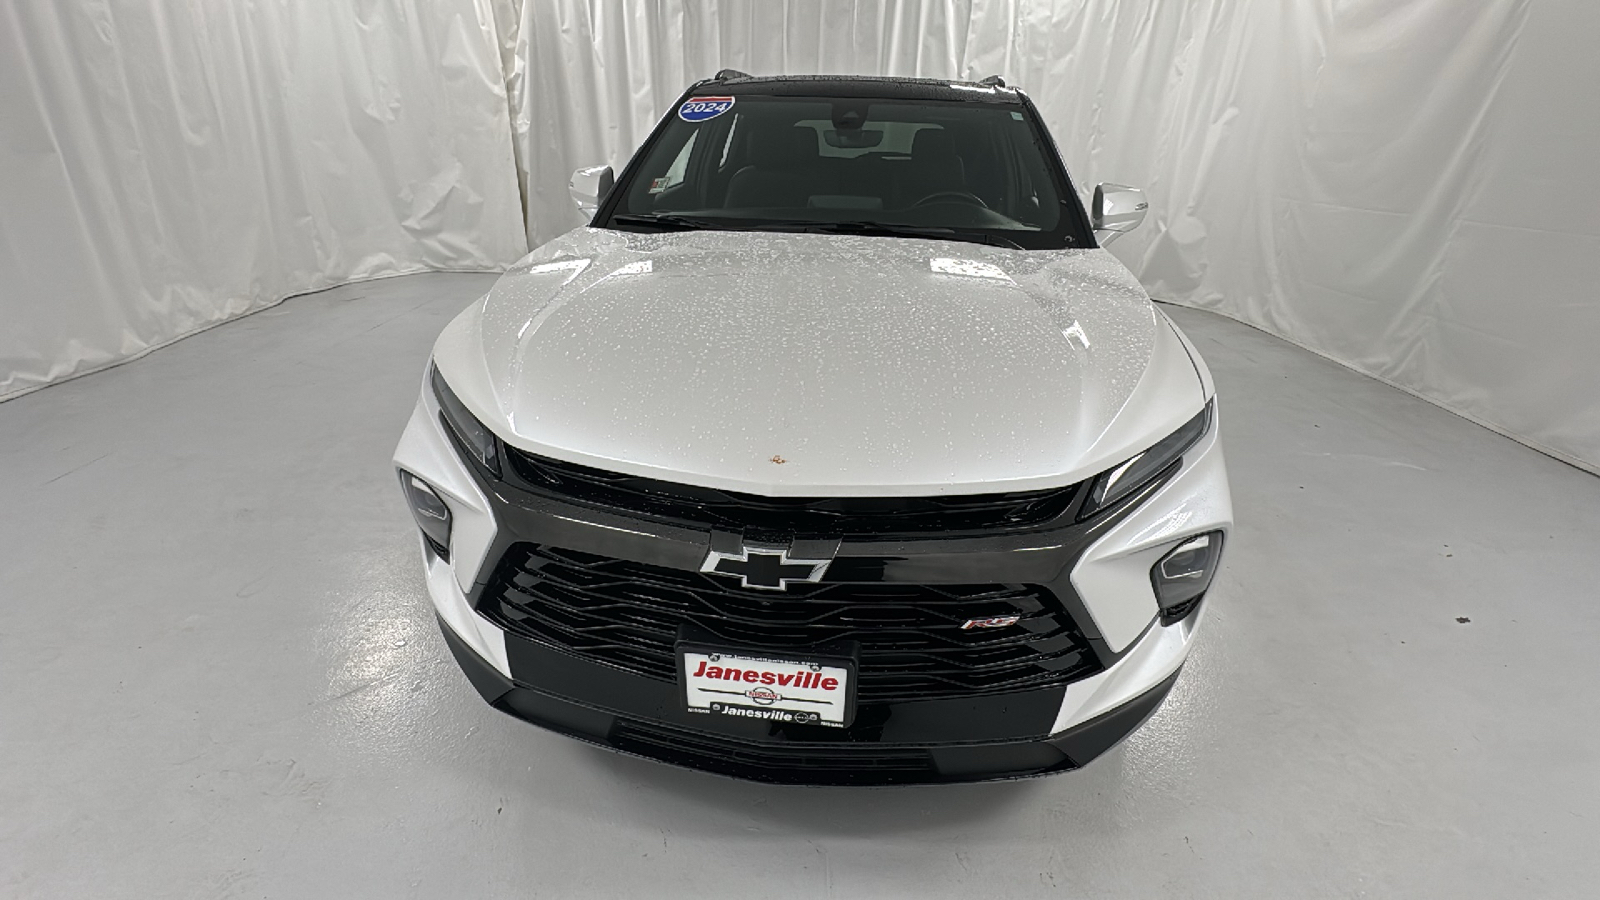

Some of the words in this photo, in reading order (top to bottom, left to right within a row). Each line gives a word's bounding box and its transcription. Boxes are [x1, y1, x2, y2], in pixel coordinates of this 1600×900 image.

[682, 102, 728, 114] 2024
[693, 661, 839, 691] Janesville
[721, 705, 793, 722] Janesville
